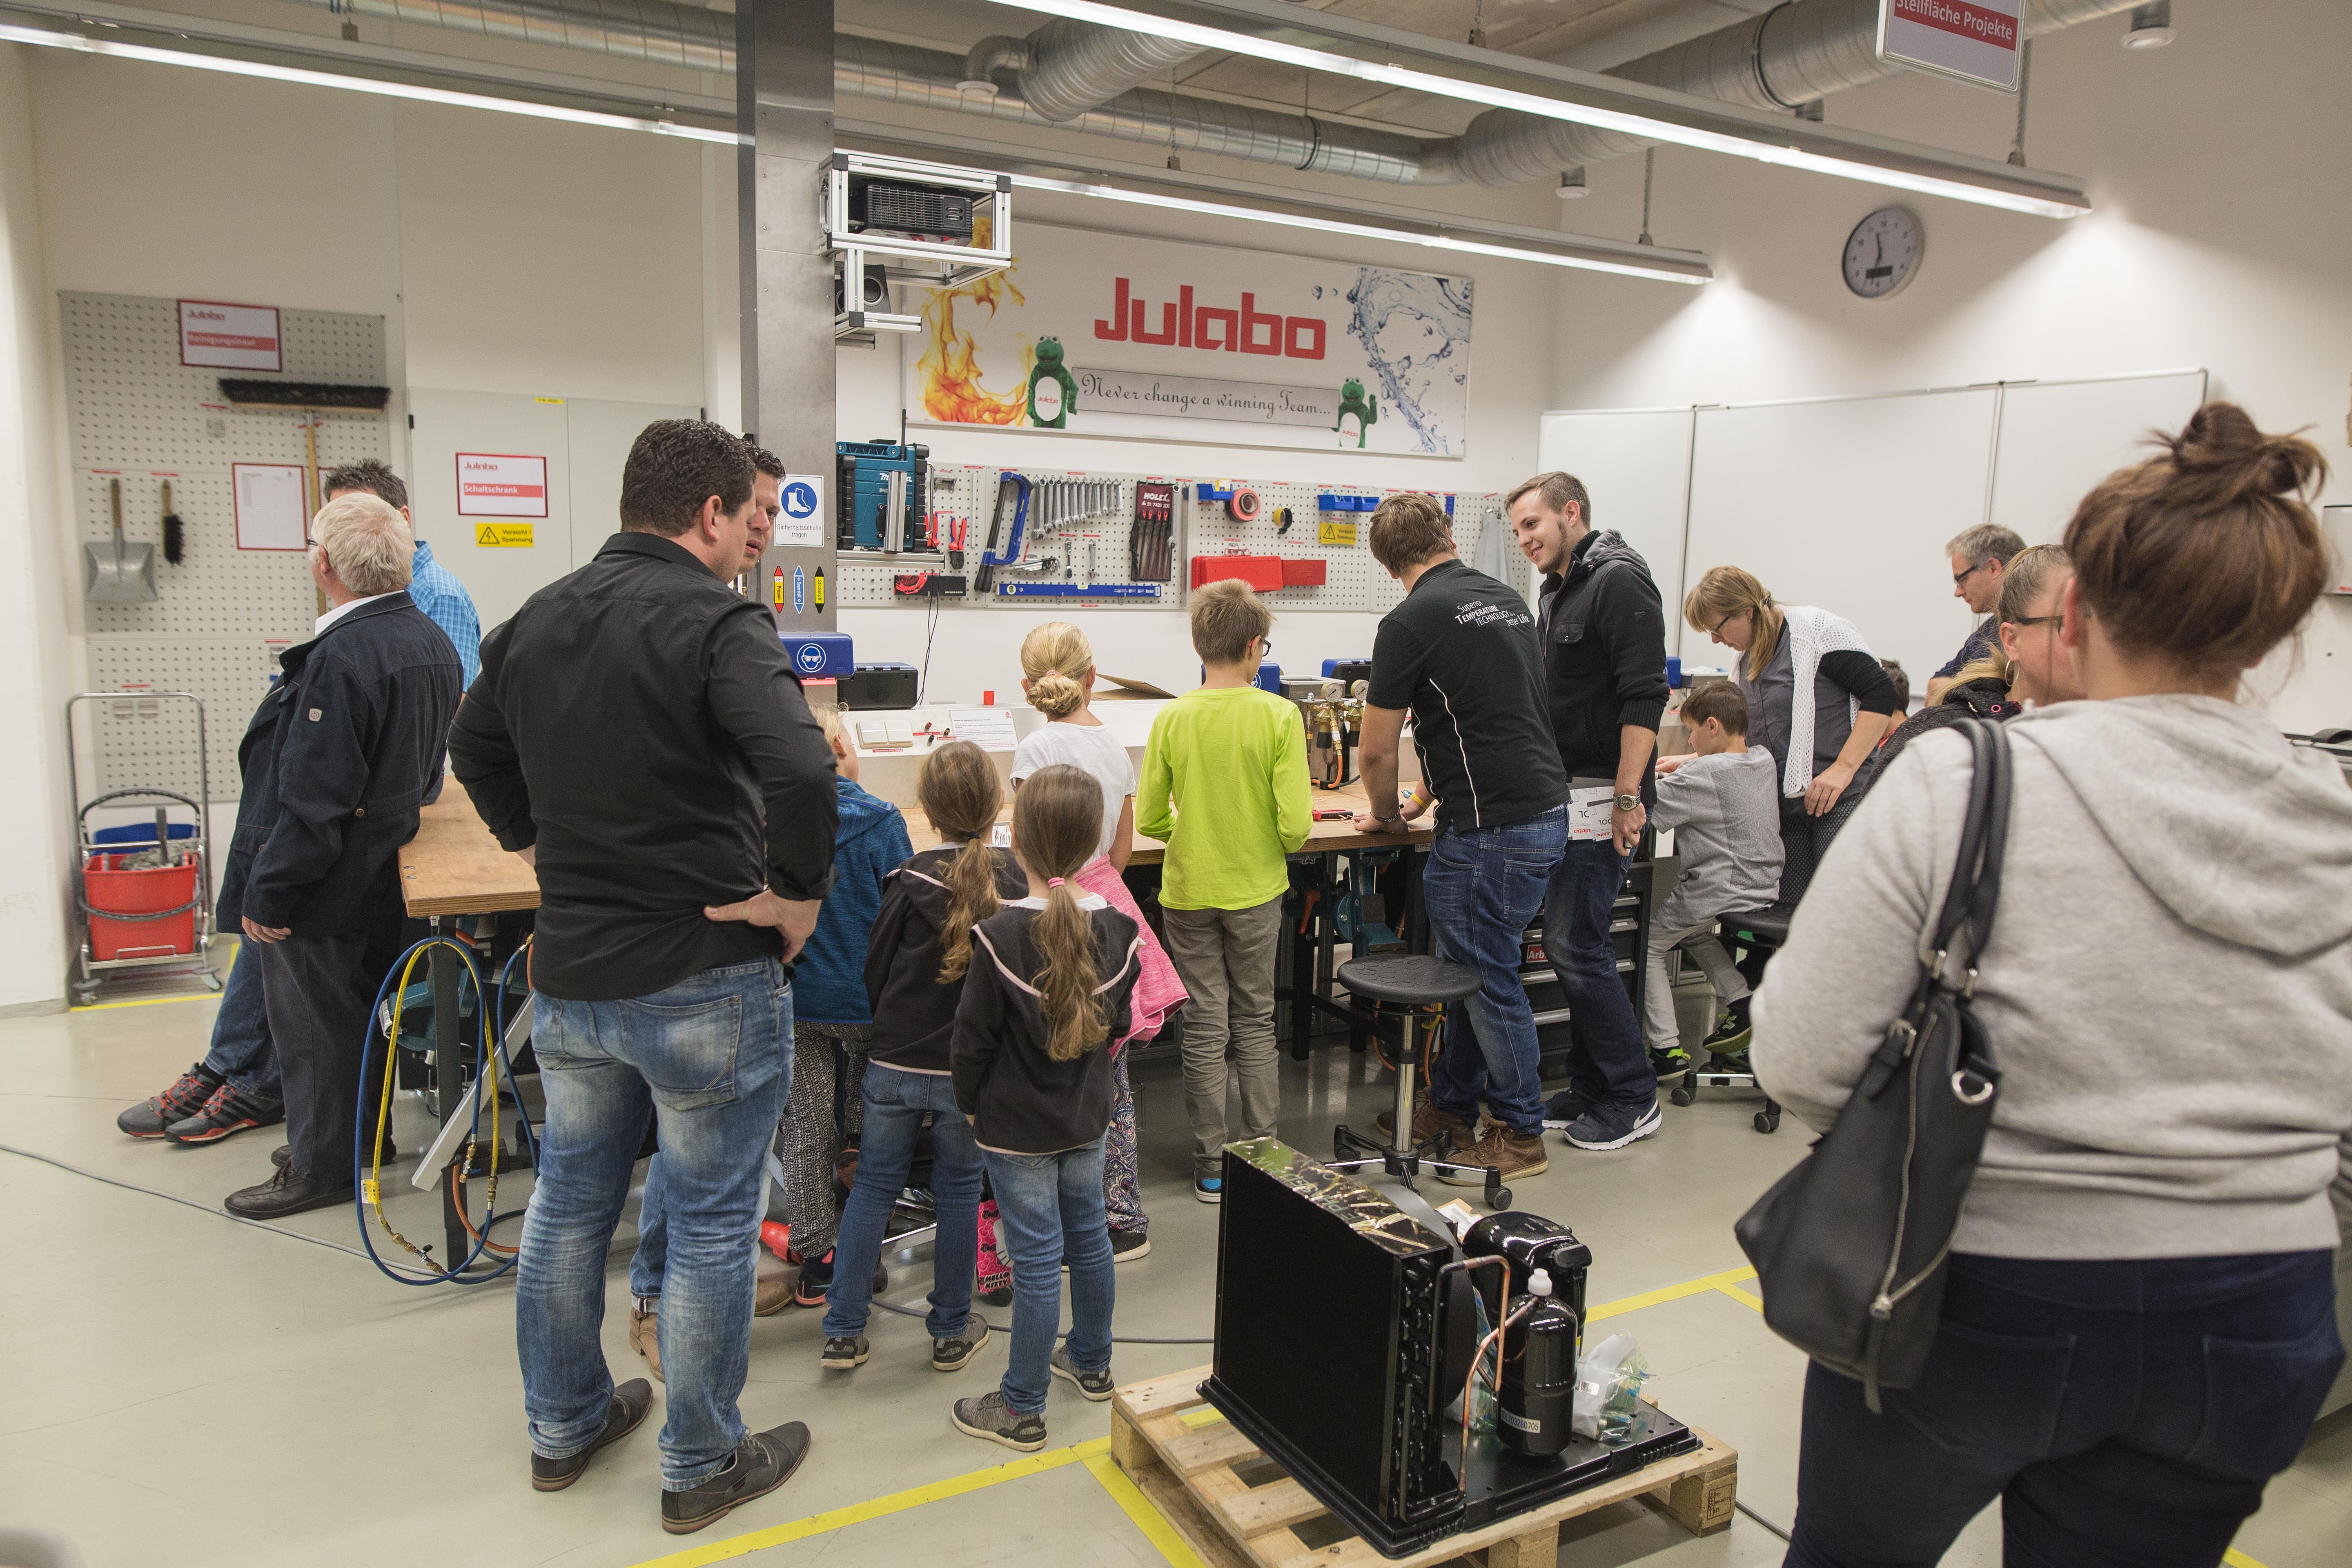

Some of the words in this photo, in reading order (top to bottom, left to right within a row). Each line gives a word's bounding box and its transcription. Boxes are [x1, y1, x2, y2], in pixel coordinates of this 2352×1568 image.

[1896, 0, 1960, 24] Stellfläche
[1964, 11, 2013, 40] Projekte
[1095, 277, 1326, 360] Julabo
[1082, 373, 1141, 400] Never
[1145, 382, 1200, 413] change
[1203, 396, 1212, 405] a
[1216, 394, 1275, 419] winning
[1279, 390, 1331, 414] Team...
[464, 461, 498, 470] Julabo
[464, 484, 518, 494] Schaltschrank
[1143, 492, 1169, 502] HOLEX
[1457, 599, 1483, 613] Superior
[1454, 605, 1499, 624] TEMPERATURE
[1474, 610, 1510, 627] TECHNOLOGY
[1505, 618, 1519, 626] better
[1517, 613, 1530, 624] Life
[1528, 950, 1546, 959] Arb
[984, 1270, 1011, 1283] HELLO
[984, 1278, 1009, 1289] KITTY
